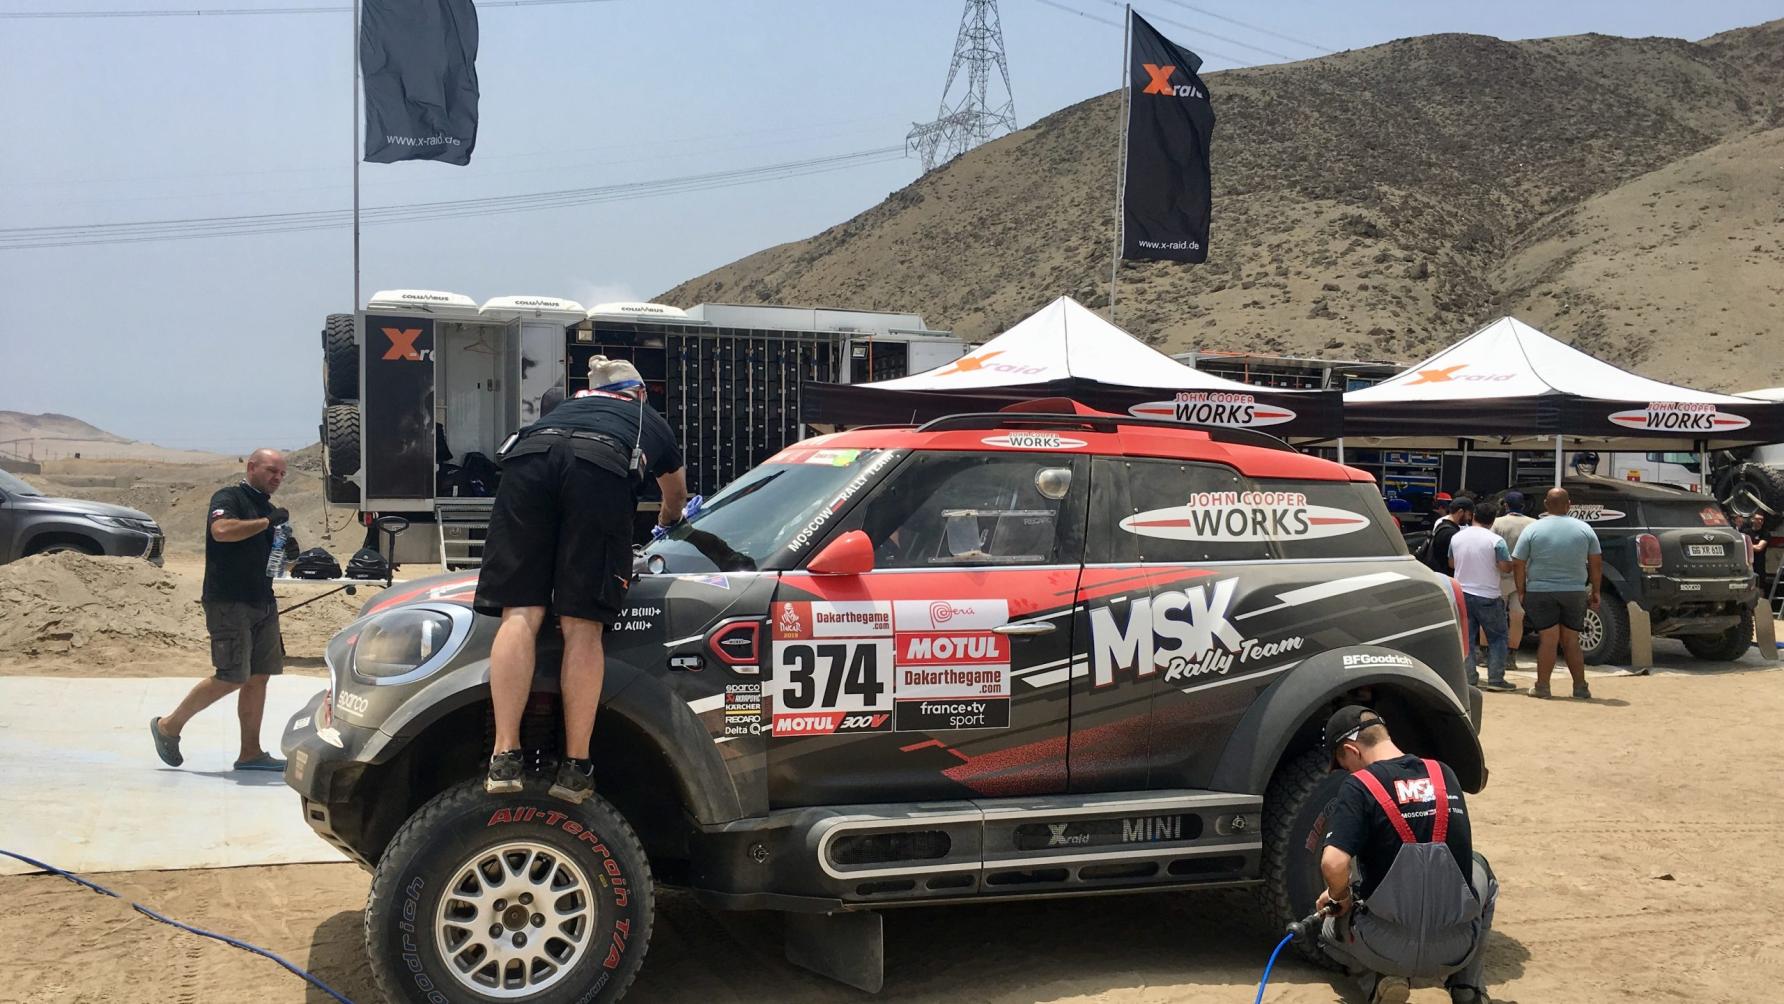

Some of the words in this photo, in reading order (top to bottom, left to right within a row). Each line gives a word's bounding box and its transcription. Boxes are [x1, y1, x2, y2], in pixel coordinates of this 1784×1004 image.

[386, 132, 461, 146] www.x-raid.de
[1138, 240, 1200, 250] www.x-raid.de
[380, 327, 434, 361] X-r
[1175, 392, 1207, 402] JOHN
[1209, 392, 1255, 404] COOPER
[1175, 403, 1255, 424] WORKS
[1648, 402, 1676, 411] JOHN
[1677, 402, 1716, 412] COOPER
[1646, 411, 1716, 429] WORKS
[1010, 437, 1060, 447] WORKS
[1190, 493, 1238, 507] JOHN
[1243, 493, 1307, 506] COOPER
[788, 506, 833, 552] MOSCOW
[841, 473, 869, 501] RALLY
[1191, 508, 1309, 537] WORKS
[631, 607, 662, 617] B(III)+
[816, 612, 889, 624] Dakarthegame
[625, 620, 653, 631] A(II)+
[780, 621, 802, 632] DAKAR
[1089, 576, 1246, 688] MSK
[907, 637, 1000, 659] MOTUL
[1164, 648, 1235, 682] Rally
[1240, 635, 1304, 663] Team
[1343, 654, 1413, 665] BFGoodrich
[783, 643, 884, 709] 374
[904, 669, 1001, 686] Dakarthegame
[725, 684, 760, 693] sparco
[979, 684, 1001, 694] .com
[338, 690, 369, 713] sparco
[725, 715, 761, 723] RECARO
[776, 716, 836, 732] MOTUL
[840, 714, 890, 729] 300V
[949, 714, 985, 727] sport
[725, 725, 748, 734] Delta
[749, 722, 761, 736] Q
[1122, 816, 1181, 842] MINI
[488, 807, 628, 907] All-Terrain
[603, 918, 631, 969] T/A
[400, 876, 450, 1004] oodrich
